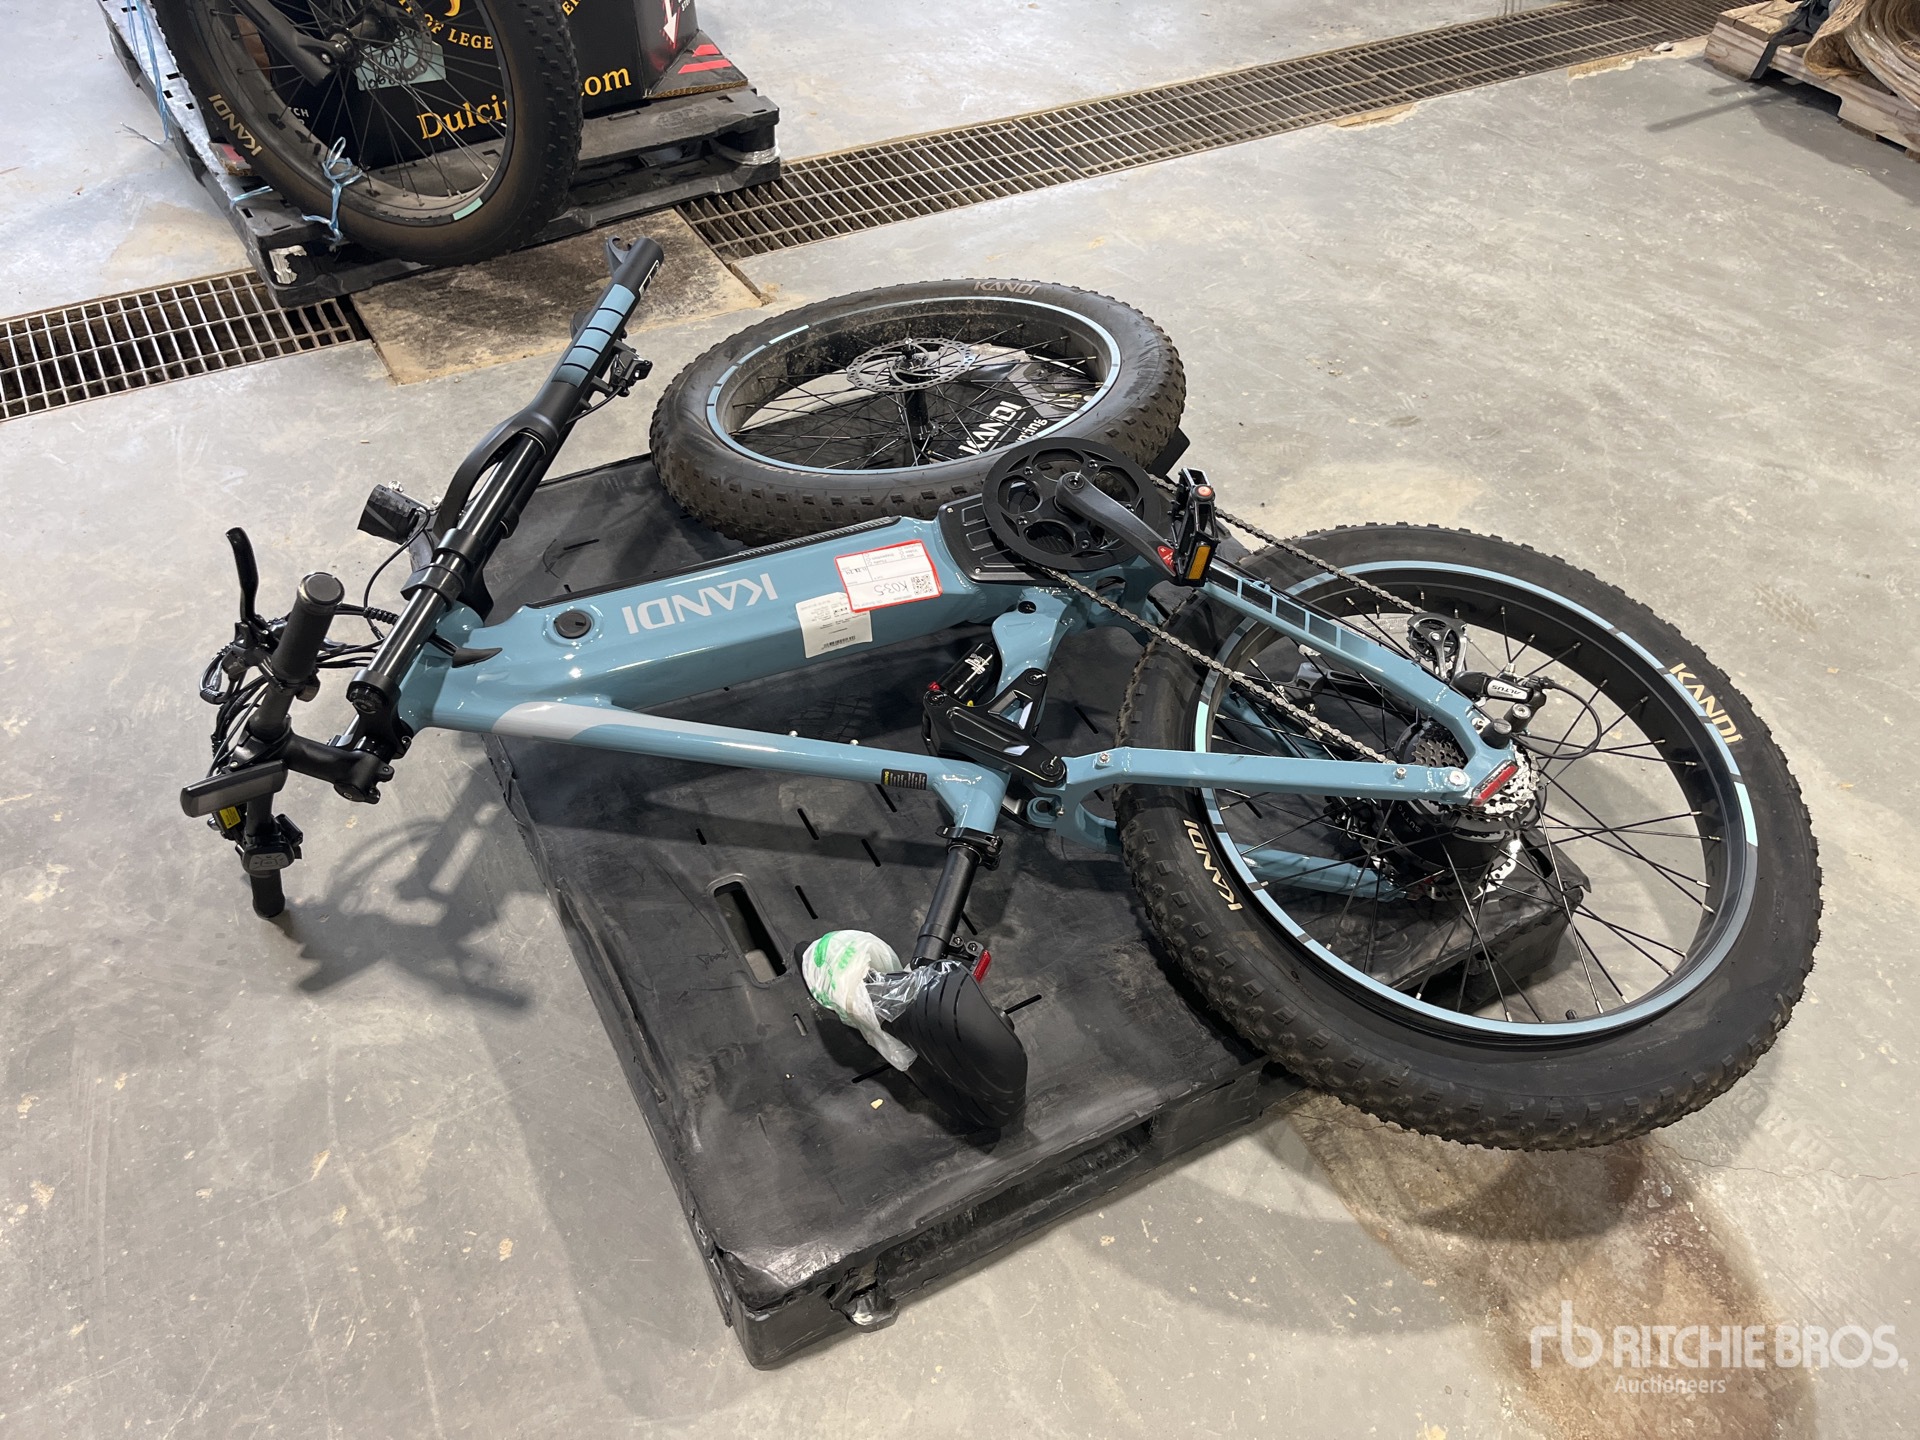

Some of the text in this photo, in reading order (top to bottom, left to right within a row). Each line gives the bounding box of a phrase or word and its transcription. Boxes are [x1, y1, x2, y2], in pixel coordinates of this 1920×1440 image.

[208, 93, 262, 156] KANDI
[973, 281, 1041, 295] KANDI
[958, 401, 1022, 455] KANDI
[622, 573, 778, 634] KANDI
[1492, 685, 1521, 695] ALTUS
[1669, 663, 1743, 744] KANDI
[1183, 820, 1243, 910] KANDI
